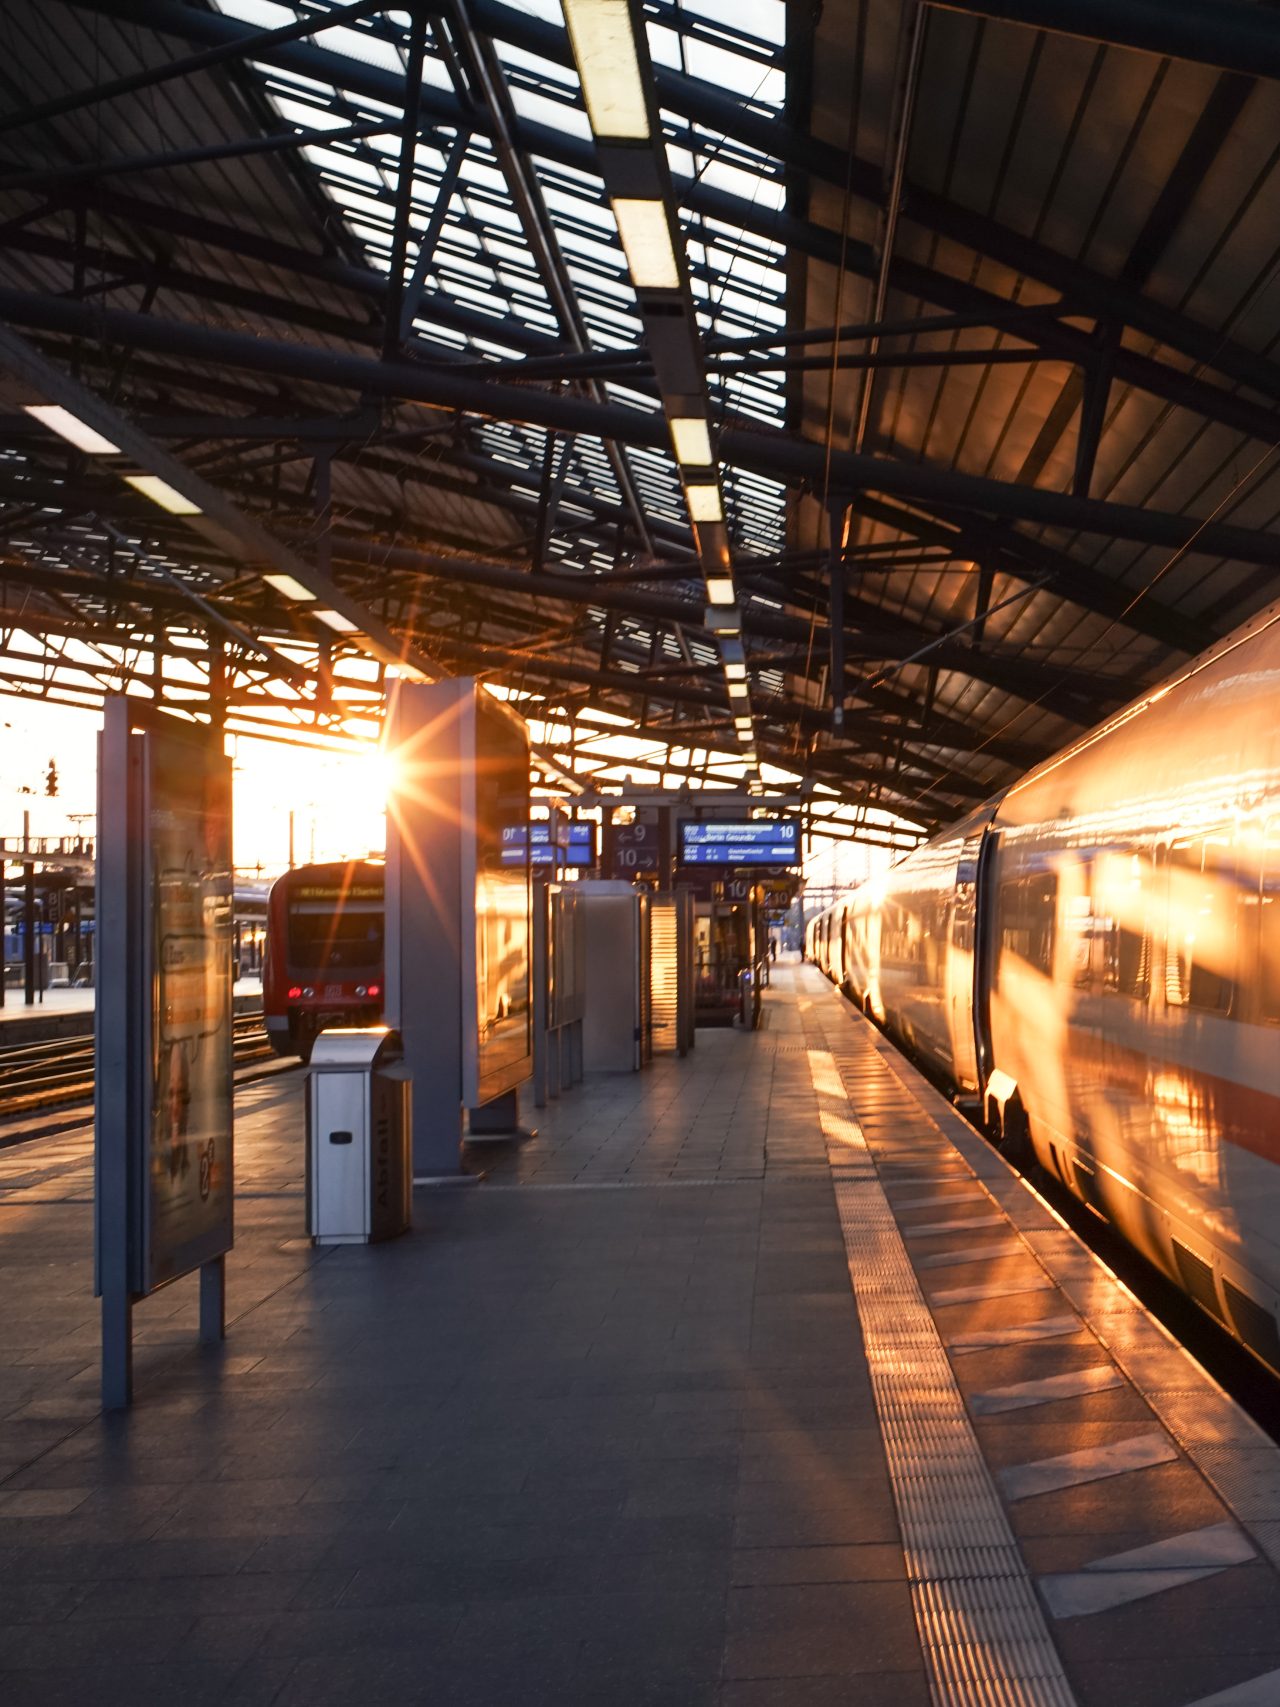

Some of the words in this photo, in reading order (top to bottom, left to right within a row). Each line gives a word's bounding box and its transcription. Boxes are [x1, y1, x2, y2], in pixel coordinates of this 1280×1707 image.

[633, 824, 647, 842] 9
[779, 824, 795, 840] 10
[616, 849, 638, 867] 10
[727, 880, 747, 898] 10
[376, 1119, 390, 1208] Abfall
